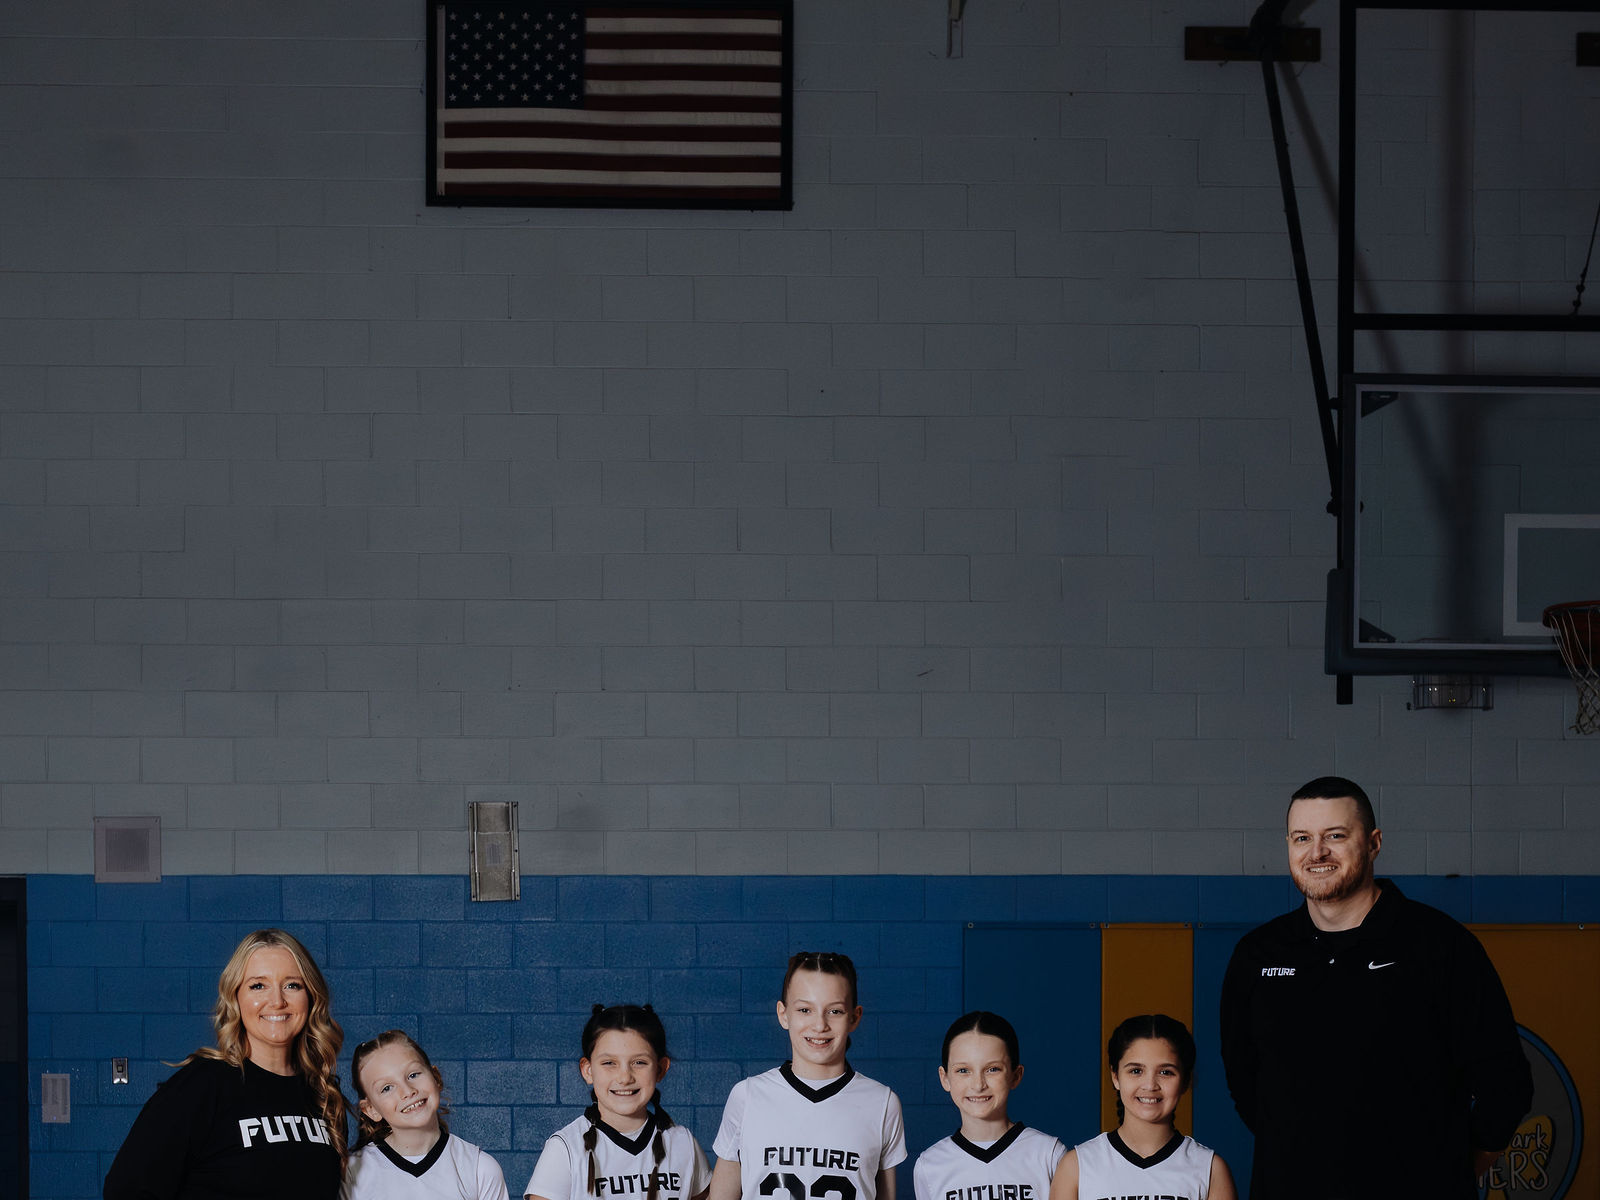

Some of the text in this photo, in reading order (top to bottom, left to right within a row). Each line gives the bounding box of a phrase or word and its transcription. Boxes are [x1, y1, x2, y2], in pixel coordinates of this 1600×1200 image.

[1262, 967, 1296, 977] FUTURE
[763, 1146, 861, 1172] FUTURE
[595, 1172, 681, 1198] FUTURE
